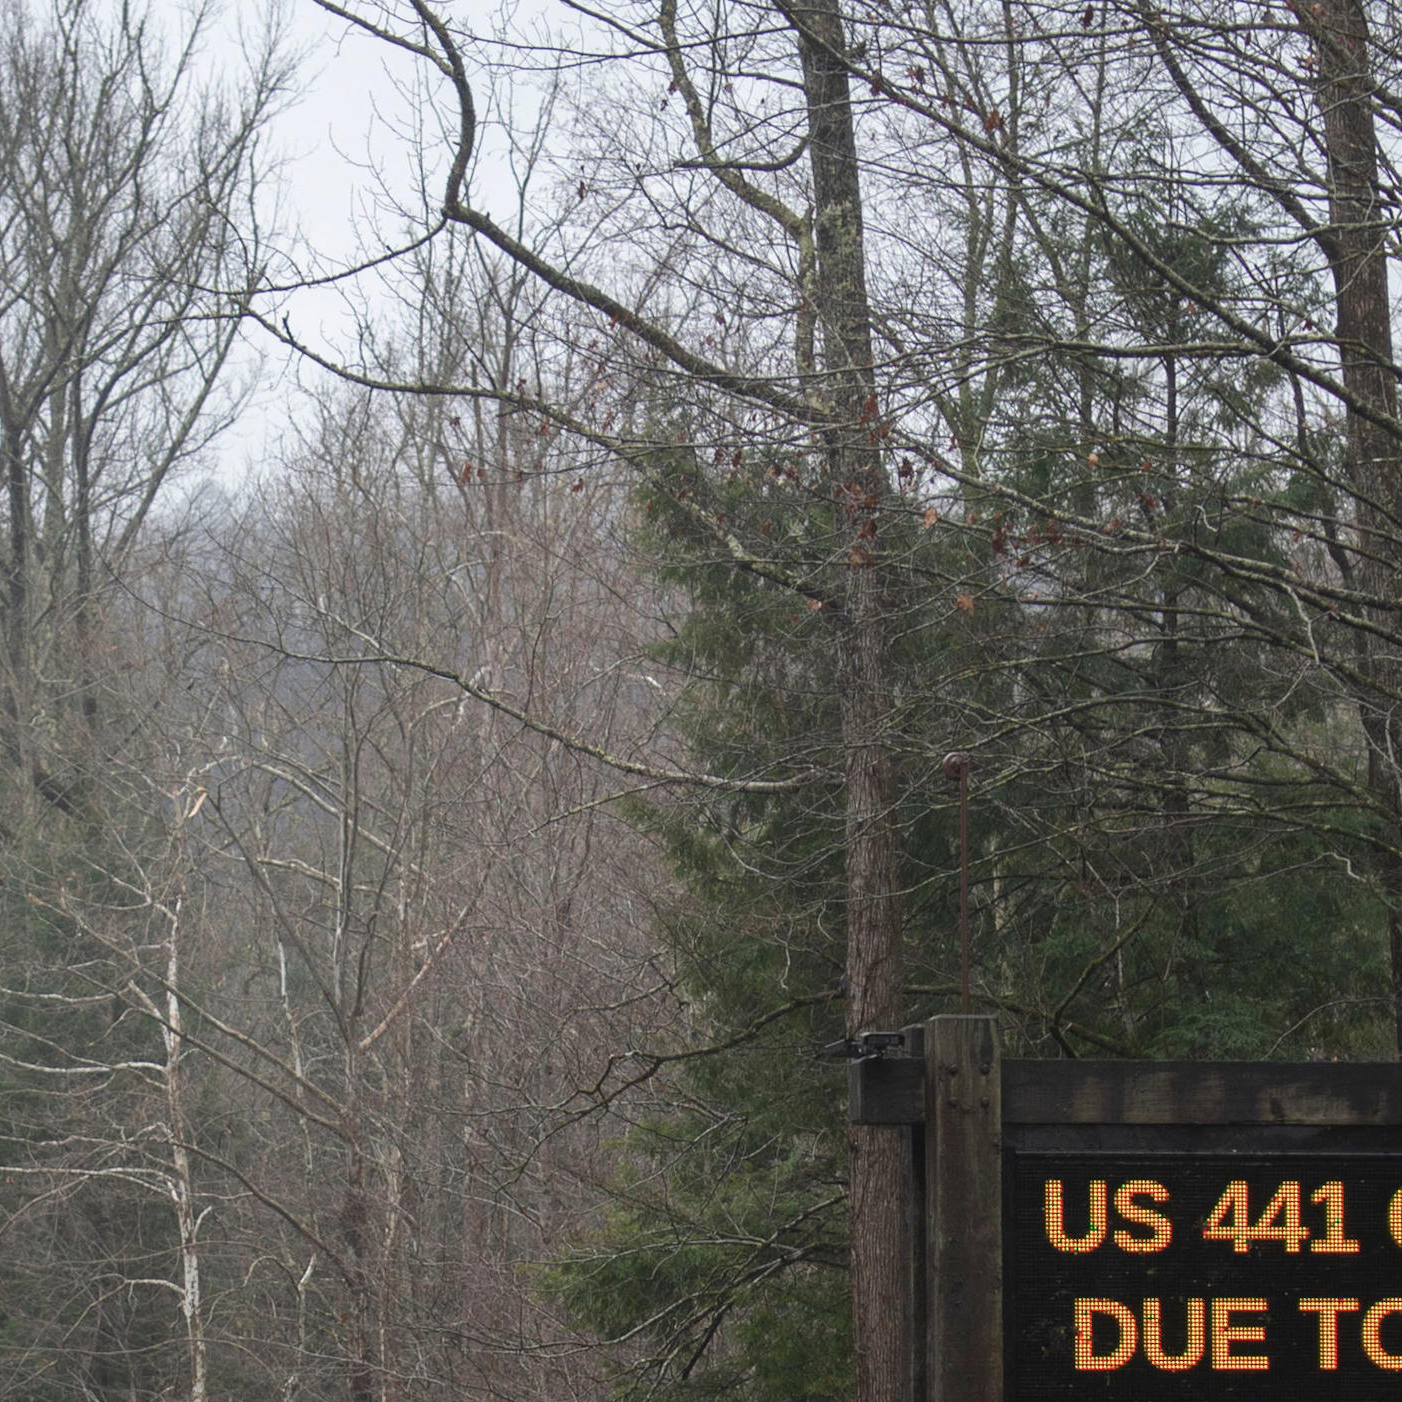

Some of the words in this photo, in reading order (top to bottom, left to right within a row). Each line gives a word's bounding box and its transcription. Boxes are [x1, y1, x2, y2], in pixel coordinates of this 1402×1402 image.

[1044, 1179, 1173, 1253] US
[1202, 1180, 1361, 1253] 441
[1073, 1297, 1271, 1371] DUE
